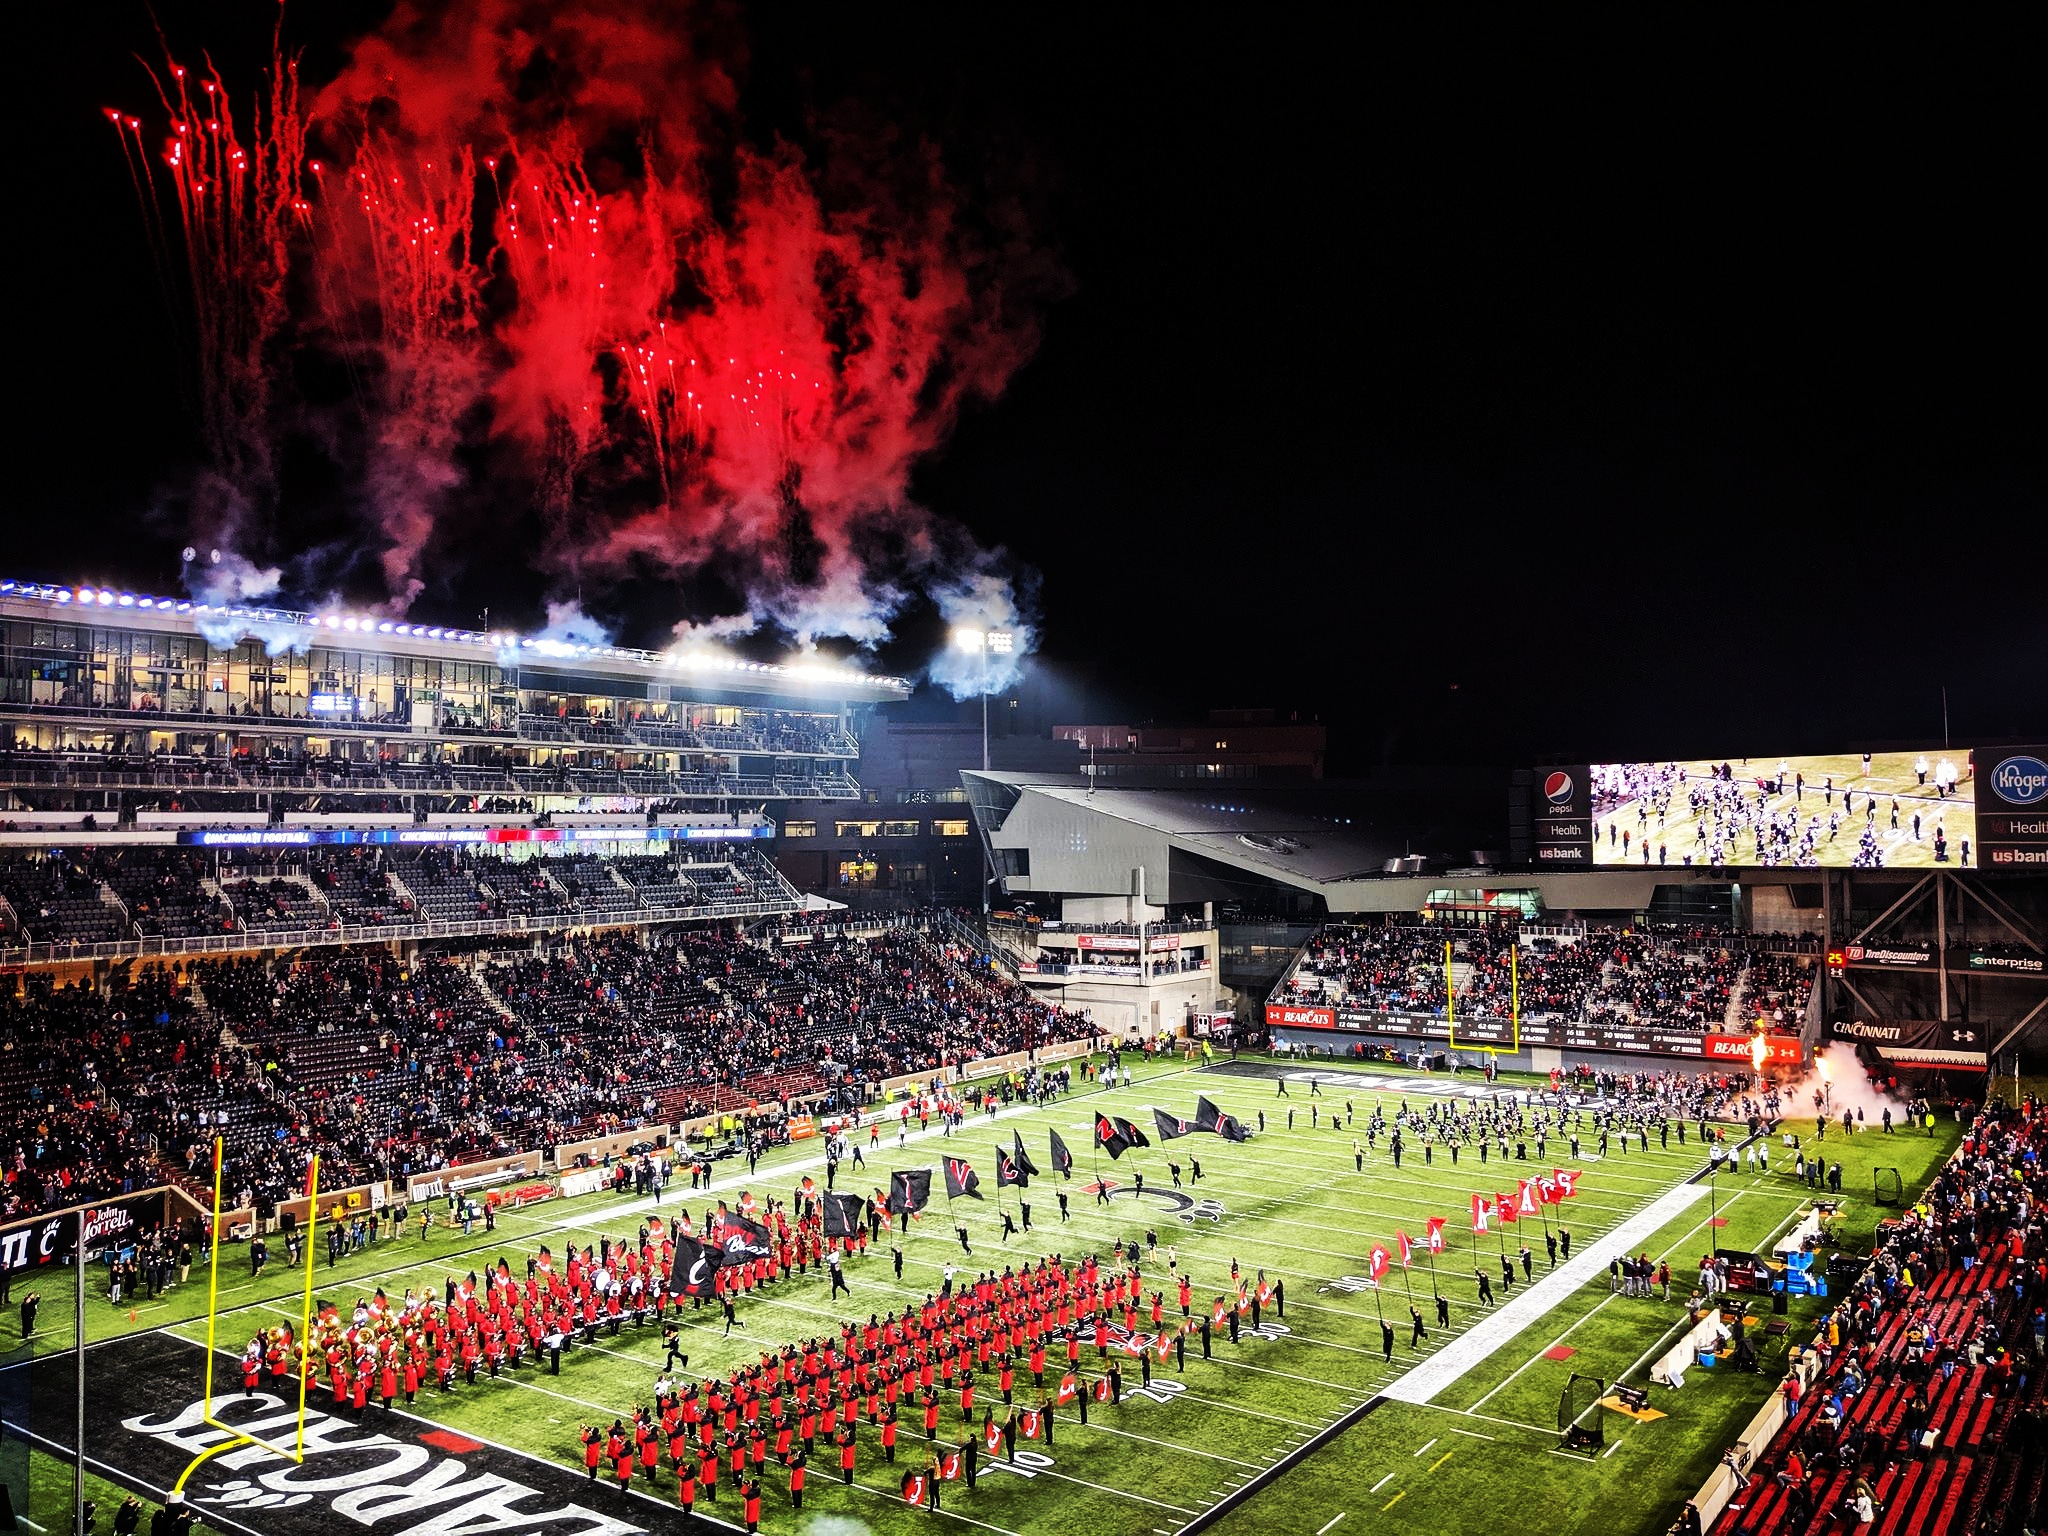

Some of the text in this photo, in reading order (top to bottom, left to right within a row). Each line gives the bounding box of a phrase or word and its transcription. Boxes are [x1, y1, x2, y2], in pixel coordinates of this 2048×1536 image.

[1999, 765, 2047, 797] Kroger
[1549, 804, 1573, 814] pepsi
[1551, 825, 1581, 835] Health
[2010, 821, 2048, 834] Healt
[204, 832, 309, 844] CINCINNATI FOOTBALL
[400, 831, 487, 842] CINCINNATI FOOTBALL
[1993, 849, 2048, 863] usban
[1828, 953, 1842, 964] 25
[1970, 957, 2043, 968] enterprise
[1284, 1011, 1329, 1025] BEARCATS
[1833, 1021, 1900, 1040] CINCINNATI
[1663, 1036, 1701, 1044] WASHINGTON
[1713, 1041, 1775, 1057] BEARCS
[94, 1206, 118, 1224] John
[1126, 1378, 1189, 1404] 20
[987, 1449, 1056, 1479] 10
